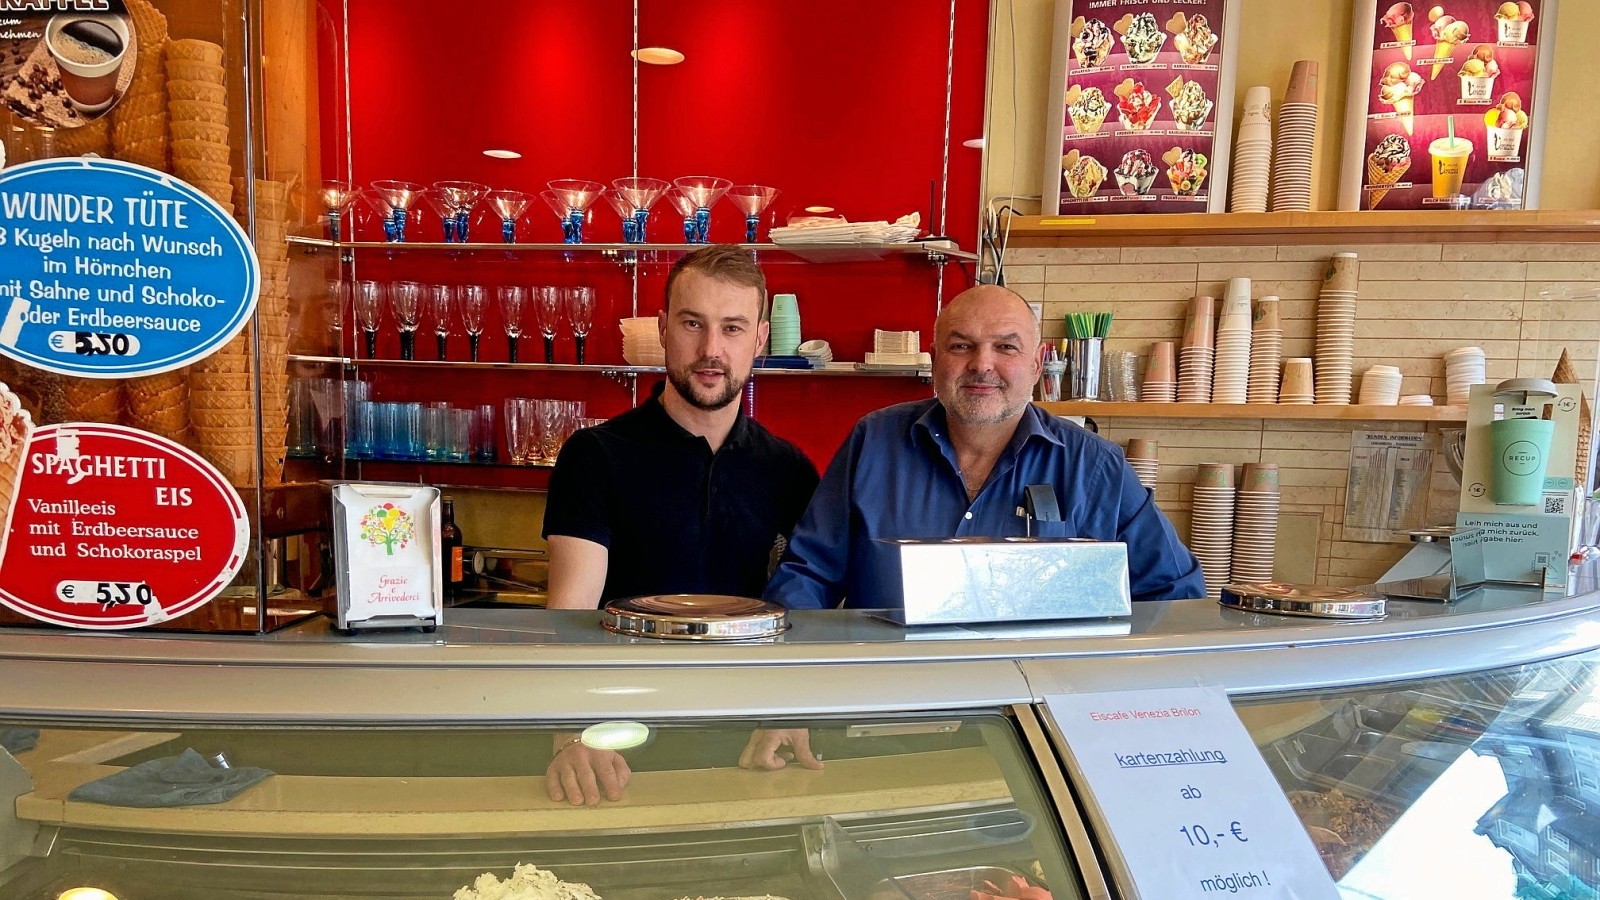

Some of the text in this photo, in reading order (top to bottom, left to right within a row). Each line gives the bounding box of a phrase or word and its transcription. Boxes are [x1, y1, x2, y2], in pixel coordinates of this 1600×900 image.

[1089, 0, 1117, 9] IMMER
[2, 190, 189, 229] WUNDER TÜTE
[15, 228, 80, 253] Kugeln
[88, 231, 135, 252] nach
[142, 235, 223, 257] Wunsch
[43, 256, 171, 280] im Hörnchen
[30, 280, 90, 302] Sahne
[98, 284, 134, 303] und
[142, 286, 225, 308] Schoko-
[20, 305, 201, 332] oder Erdbeersauce
[32, 453, 165, 479] SPAGHETTI
[156, 487, 193, 506] EIS
[28, 498, 116, 516] Vanilleeis
[29, 521, 199, 539] mit Erdbeersauce
[1483, 520, 1504, 528] mich
[30, 543, 201, 563] und Schokoraspel
[379, 575, 408, 588] Grazie
[368, 592, 420, 603] Arrivederci
[1090, 707, 1201, 722] Eiscafe Venezia Brilon
[1114, 749, 1227, 767] kartenzahlung
[1180, 785, 1202, 800] ab
[1179, 821, 1248, 849] 10,- €
[1200, 872, 1261, 894] möglich
